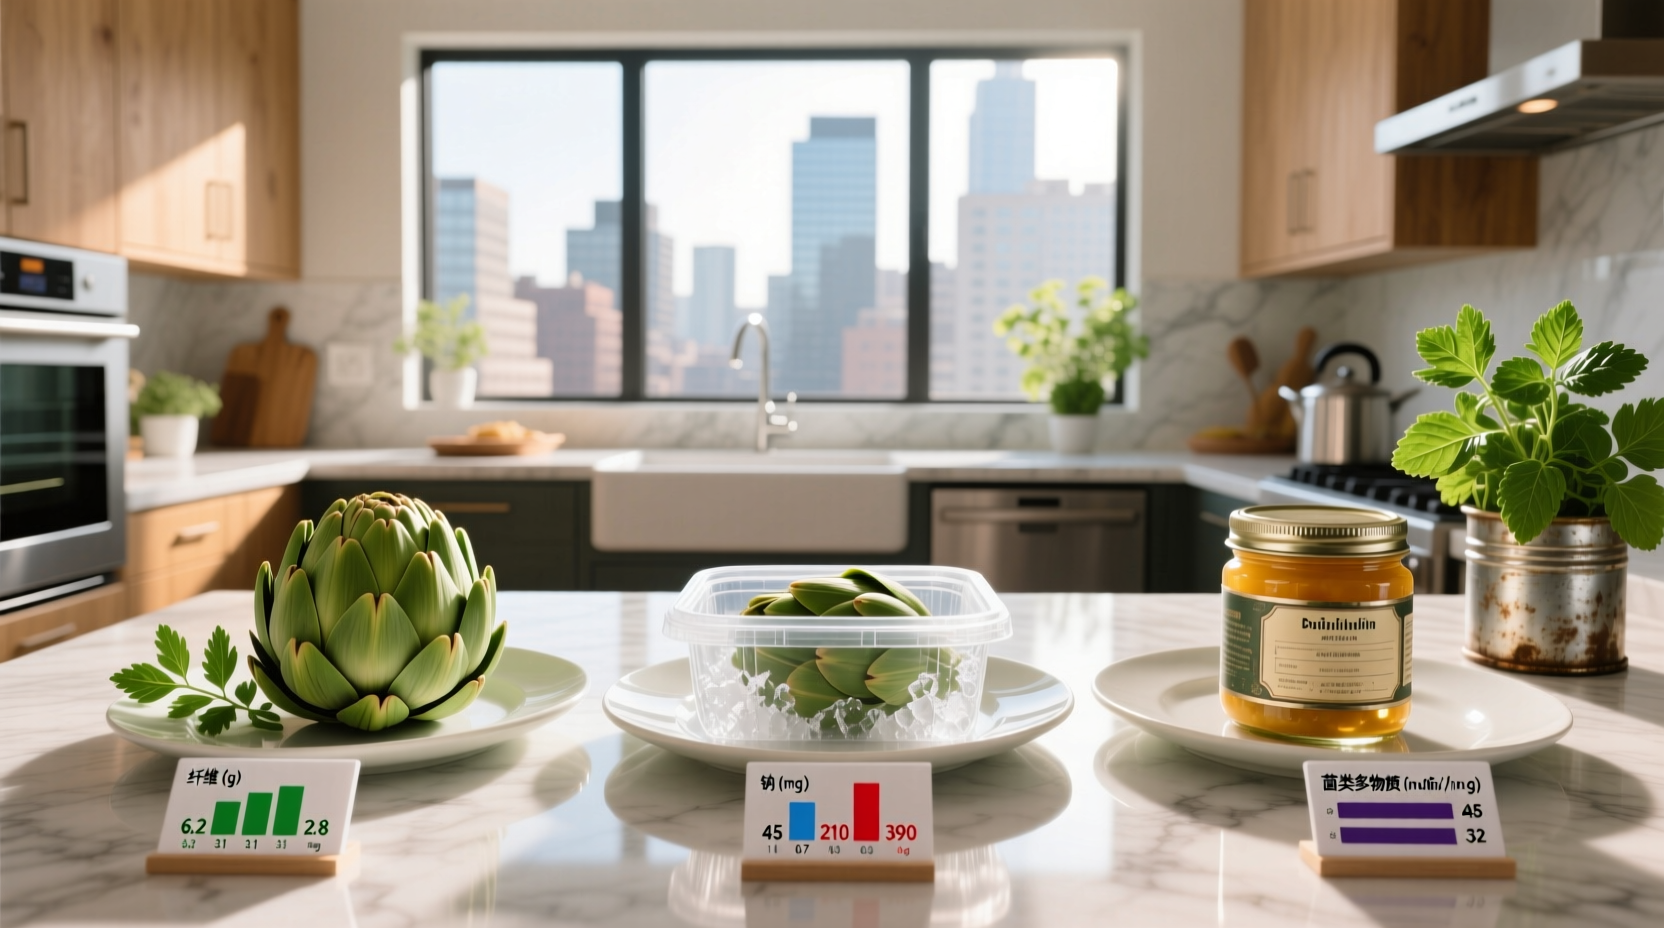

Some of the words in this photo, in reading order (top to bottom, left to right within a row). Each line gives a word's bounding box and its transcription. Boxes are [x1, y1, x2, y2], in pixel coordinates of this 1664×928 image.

[186, 767, 219, 786] 纤维
[222, 768, 241, 788] (g)
[778, 774, 809, 794] (mg)
[1461, 803, 1483, 818] 45
[181, 818, 207, 835] 6.2
[303, 819, 329, 836] 2.8
[762, 824, 783, 841] 45
[820, 823, 849, 841] 210
[885, 824, 917, 841] 390
[1465, 828, 1488, 844] 32
